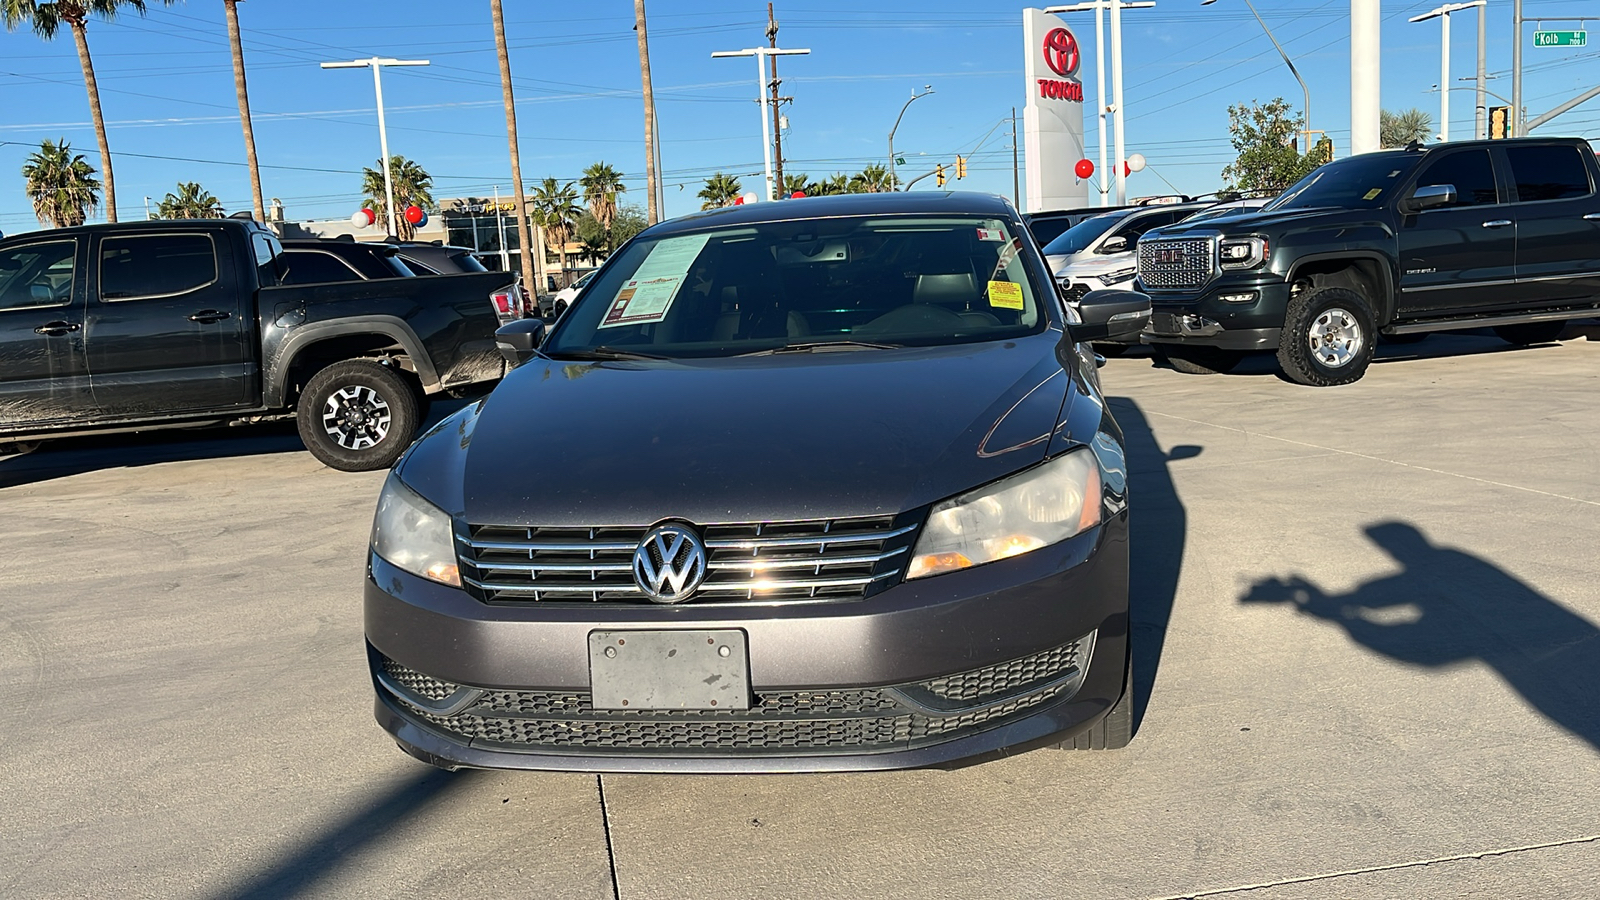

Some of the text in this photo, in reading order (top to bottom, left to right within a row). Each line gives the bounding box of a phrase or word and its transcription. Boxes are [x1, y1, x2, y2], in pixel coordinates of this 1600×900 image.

[1540, 33, 1559, 45] Kolb
[1037, 79, 1084, 102] TOYOTA
[1154, 249, 1184, 263] GMC
